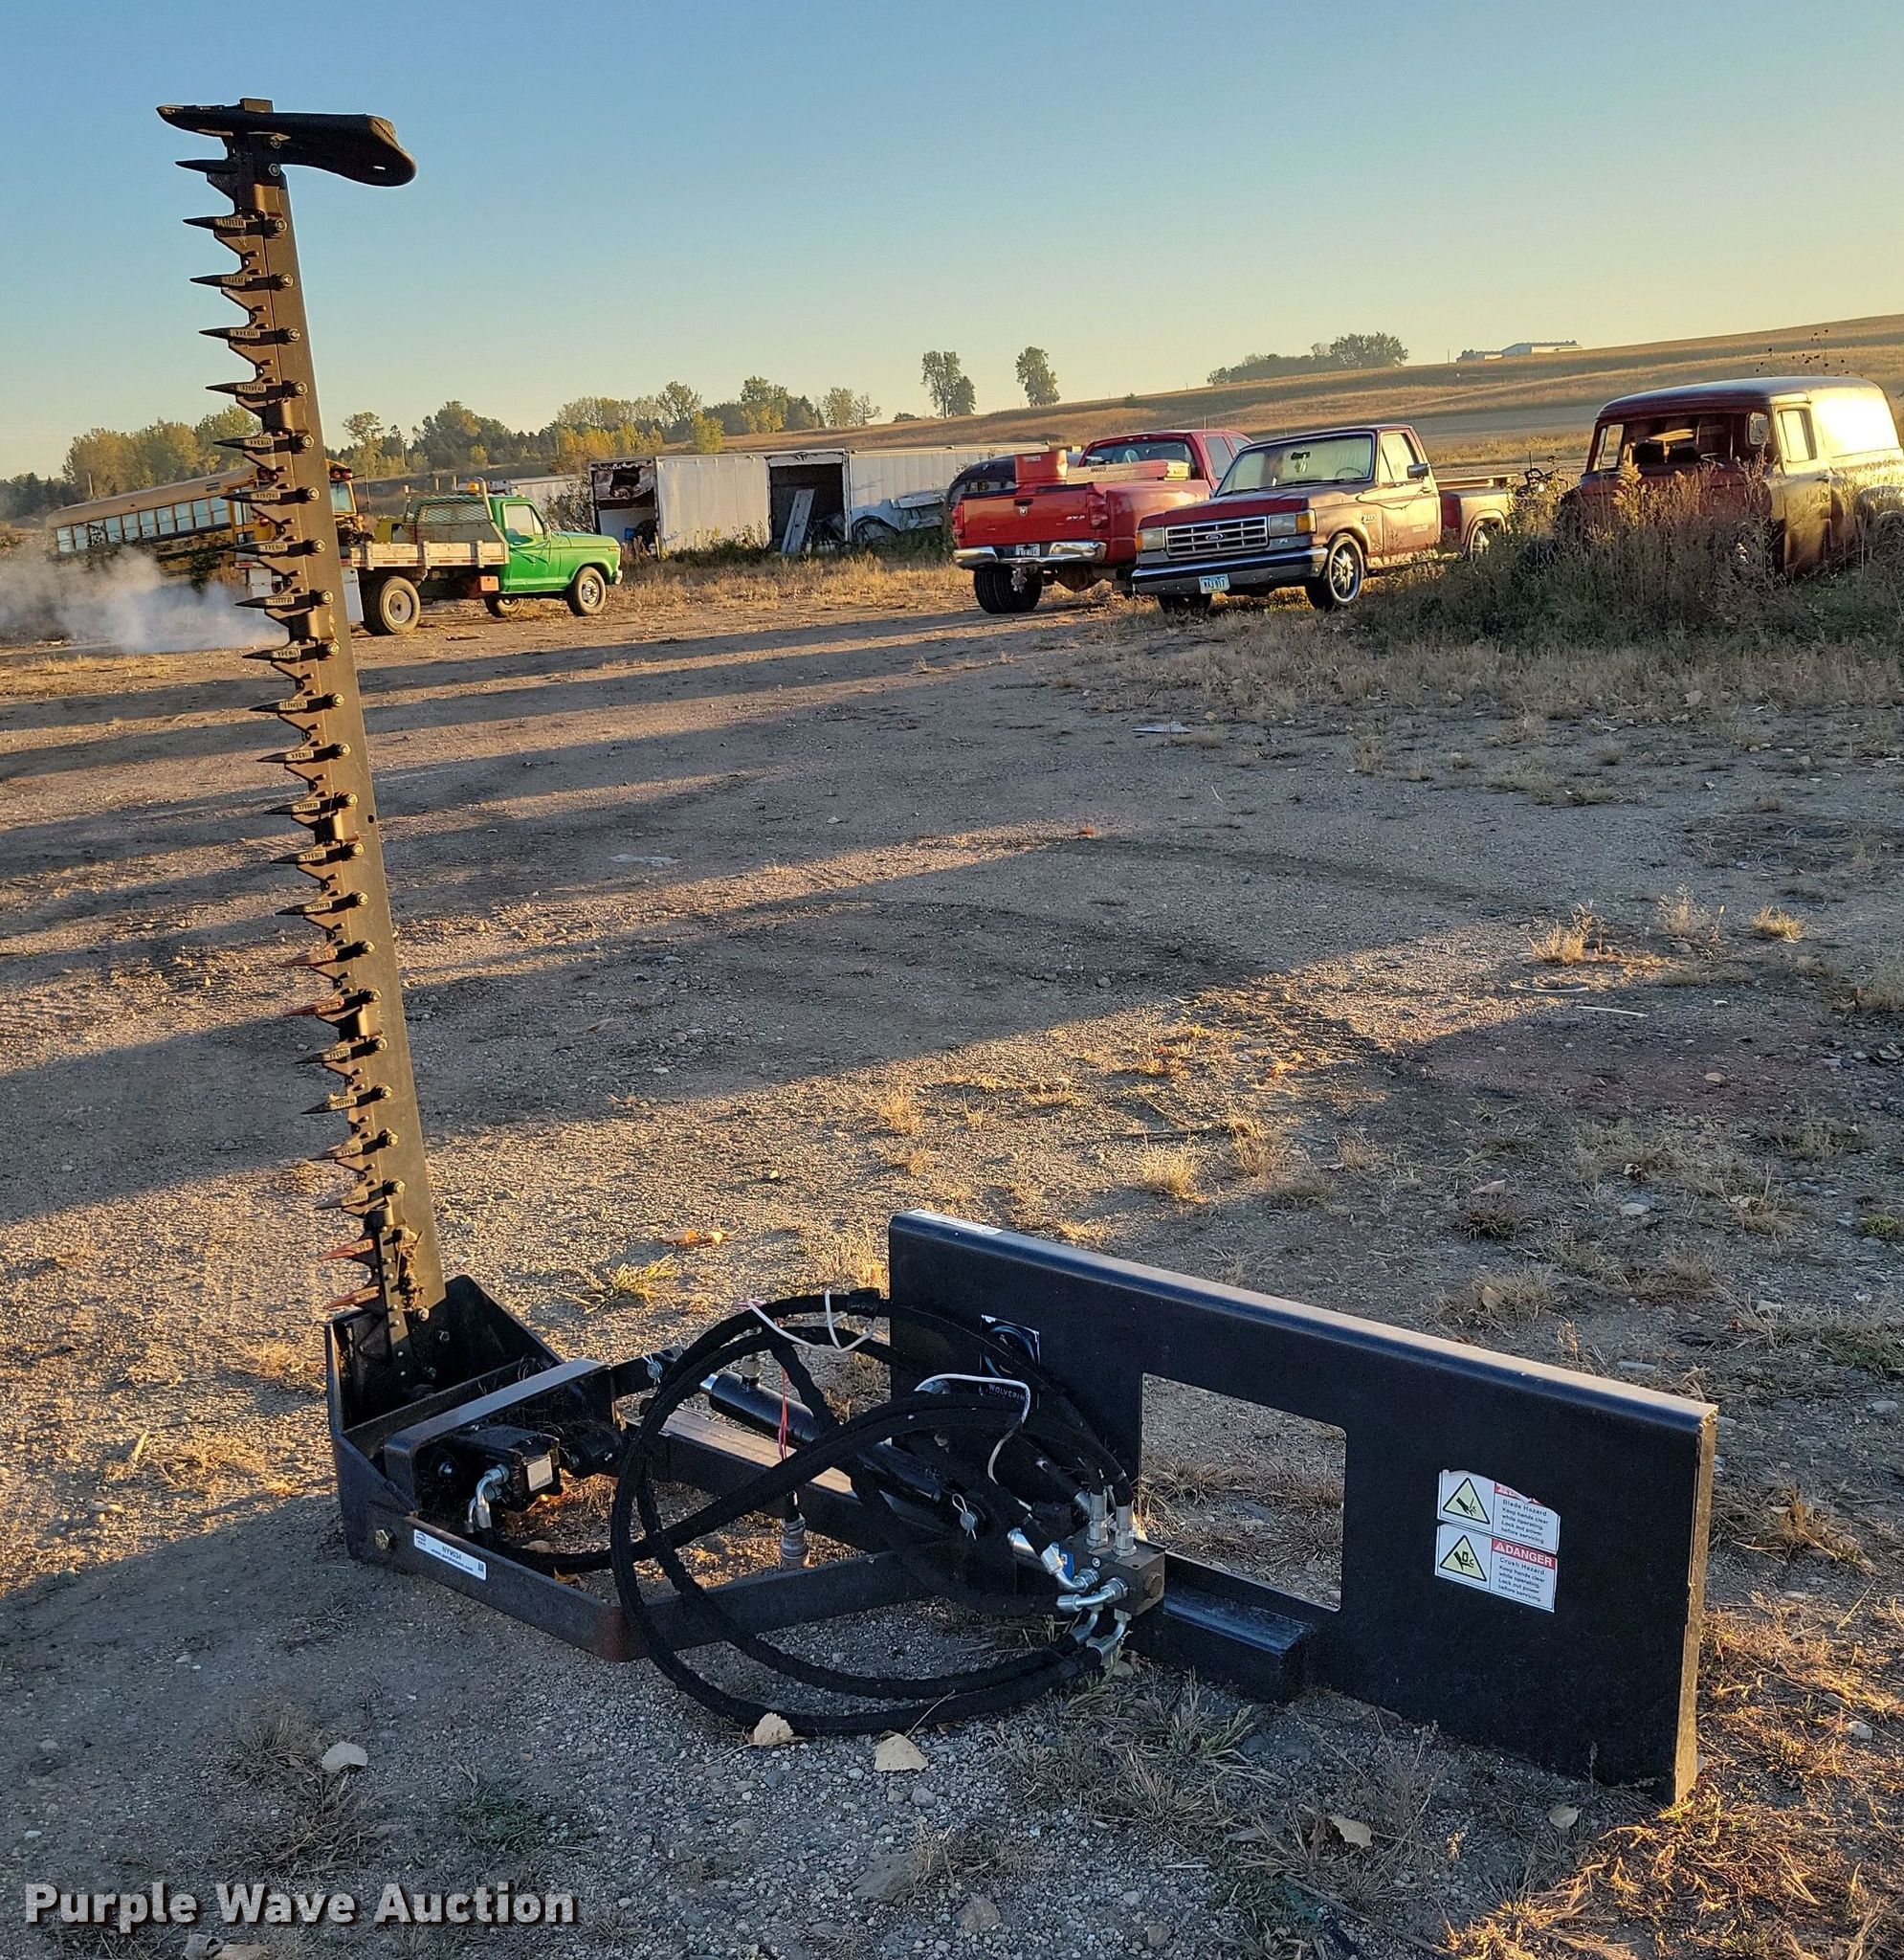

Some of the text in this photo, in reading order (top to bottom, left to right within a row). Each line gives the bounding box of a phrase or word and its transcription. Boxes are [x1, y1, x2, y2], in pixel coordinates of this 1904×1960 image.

[988, 1383, 1026, 1400] WOLVERIN
[1503, 1499, 1547, 1517] Blade Hazard
[1517, 1512, 1534, 1521] hands
[1506, 1545, 1552, 1567] DANGER
[1499, 1557, 1544, 1575] Crush Hazard
